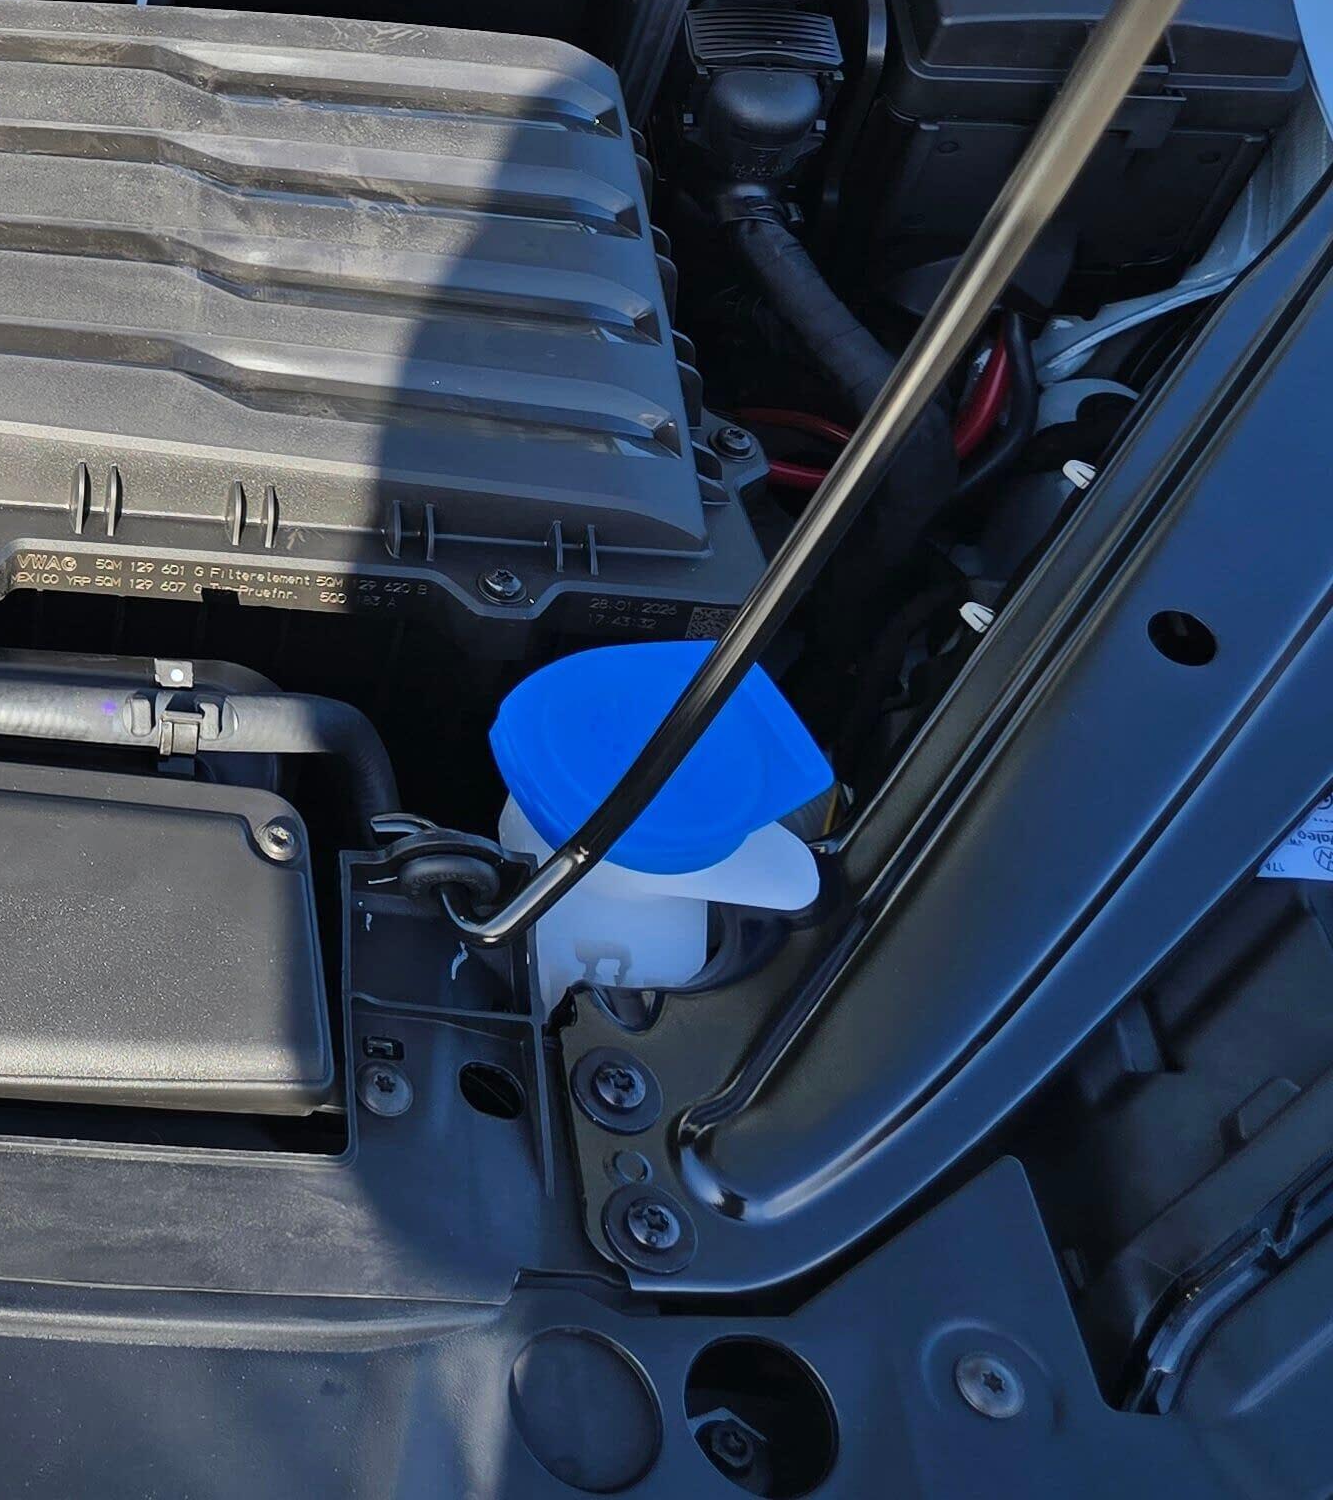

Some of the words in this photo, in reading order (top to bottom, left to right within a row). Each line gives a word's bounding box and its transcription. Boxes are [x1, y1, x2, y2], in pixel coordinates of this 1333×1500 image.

[11, 572, 59, 584] MEXICO
[66, 575, 91, 587] YRP
[95, 576, 122, 588] 5QM
[129, 578, 153, 591] 129
[159, 580, 187, 593] 607
[17, 554, 77, 572] VWAG
[95, 558, 123, 570] 5QM
[131, 561, 155, 574] 129
[161, 564, 185, 576] 601
[194, 566, 204, 578] G
[210, 567, 311, 586] Filterelement
[316, 576, 343, 588] 5QM
[384, 582, 411, 593] 620
